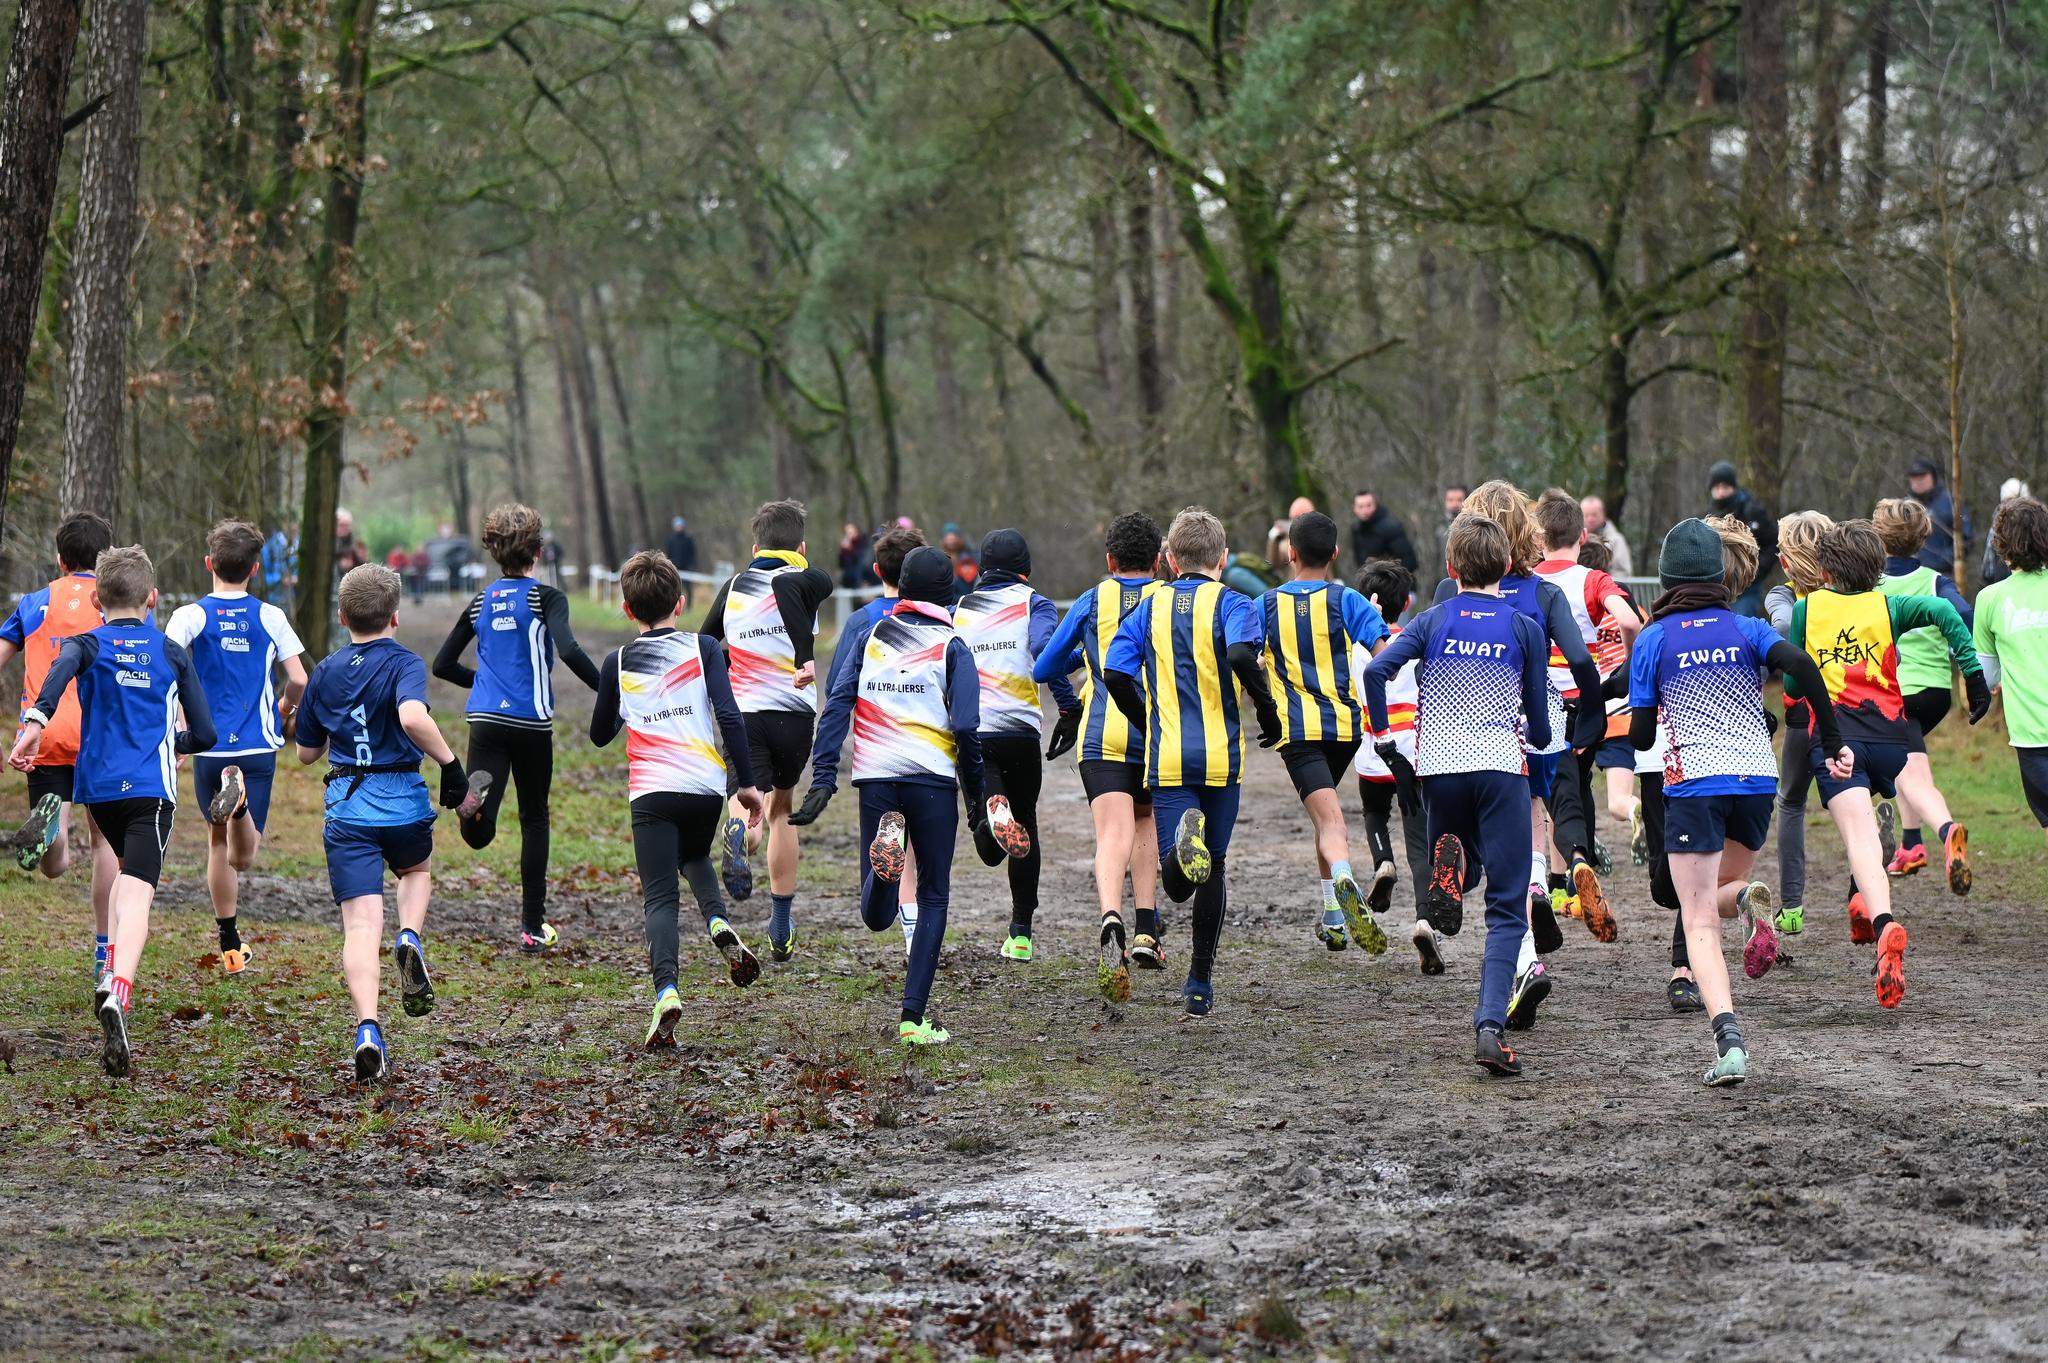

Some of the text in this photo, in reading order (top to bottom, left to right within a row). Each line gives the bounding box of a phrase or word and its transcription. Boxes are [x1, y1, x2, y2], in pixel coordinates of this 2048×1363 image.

[739, 625, 788, 640] AV LYRA-LIERS
[1836, 626, 1857, 645] AC
[229, 637, 250, 645] ACHL
[973, 640, 1017, 653] LYRA-LIERSE
[1443, 639, 1507, 658] ZWAT
[1817, 641, 1881, 669] BREAK
[114, 653, 136, 663] TSG
[1676, 646, 1740, 669] ZWAT
[125, 670, 151, 679] ACHL
[866, 682, 926, 694] AV LYRA-LIERSE
[643, 715, 652, 725] AV
